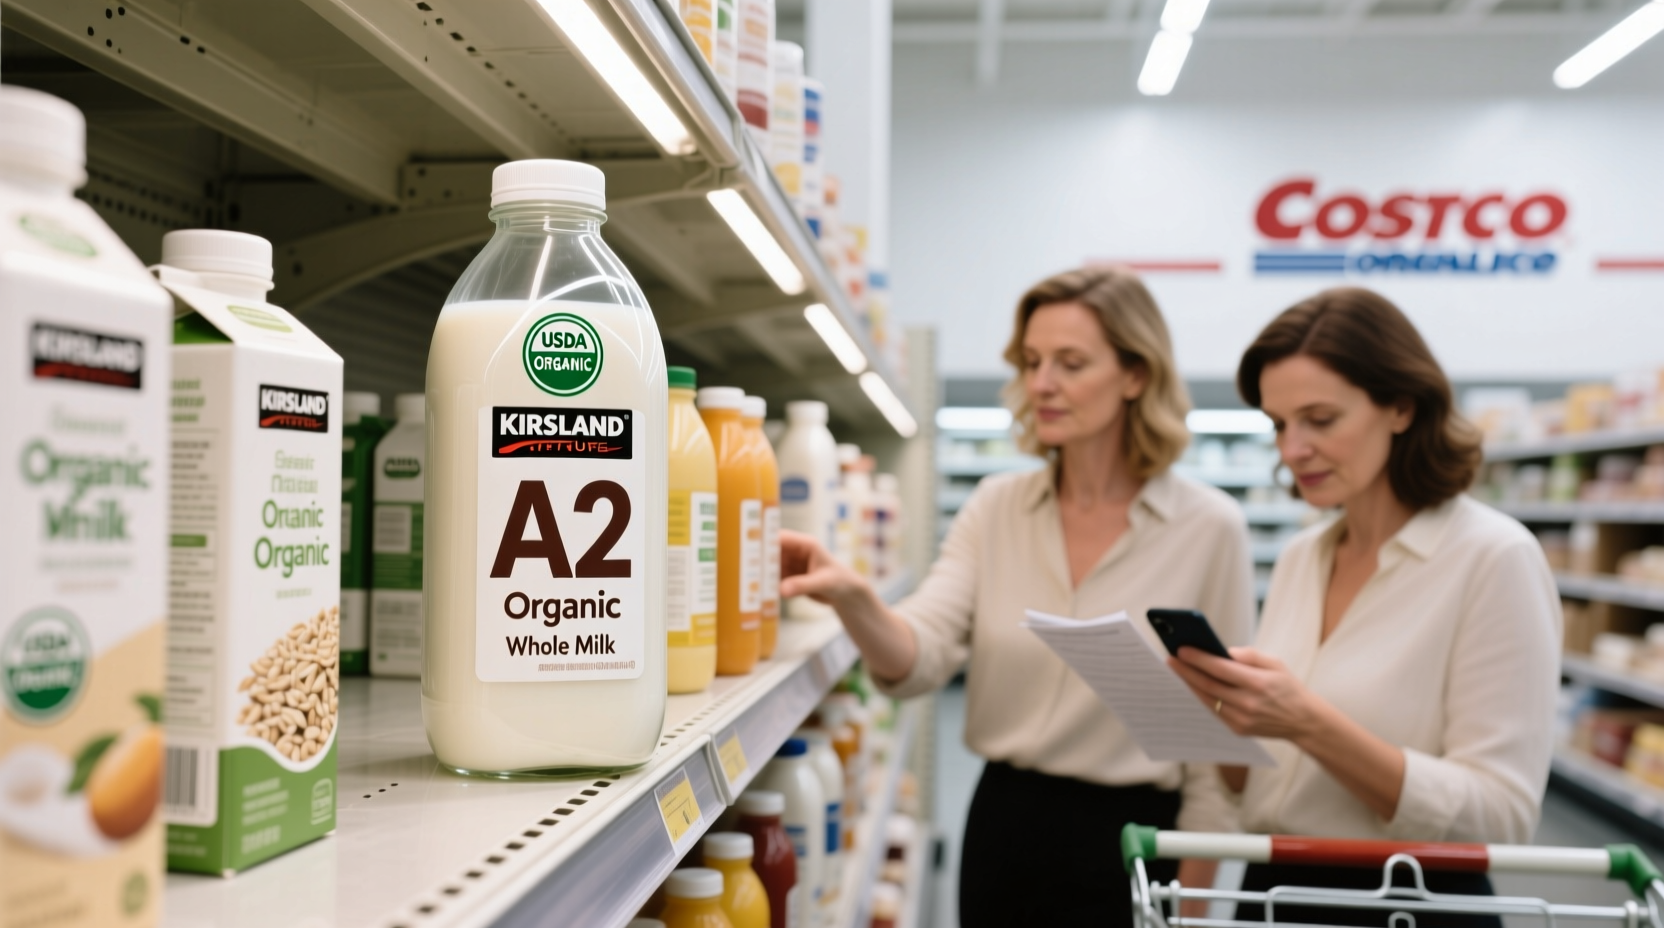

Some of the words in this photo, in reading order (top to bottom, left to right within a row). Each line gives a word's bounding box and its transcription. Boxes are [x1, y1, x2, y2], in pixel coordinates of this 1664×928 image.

[541, 331, 588, 350] USDA
[533, 355, 592, 372] ORGANIC
[261, 388, 327, 416] KIRSLAND
[500, 412, 625, 437] KIRSLAND
[489, 479, 632, 579] A2
[254, 535, 330, 579] Organic
[504, 589, 621, 628] Organic
[506, 634, 569, 657] Whole
[575, 633, 616, 656] Milk
